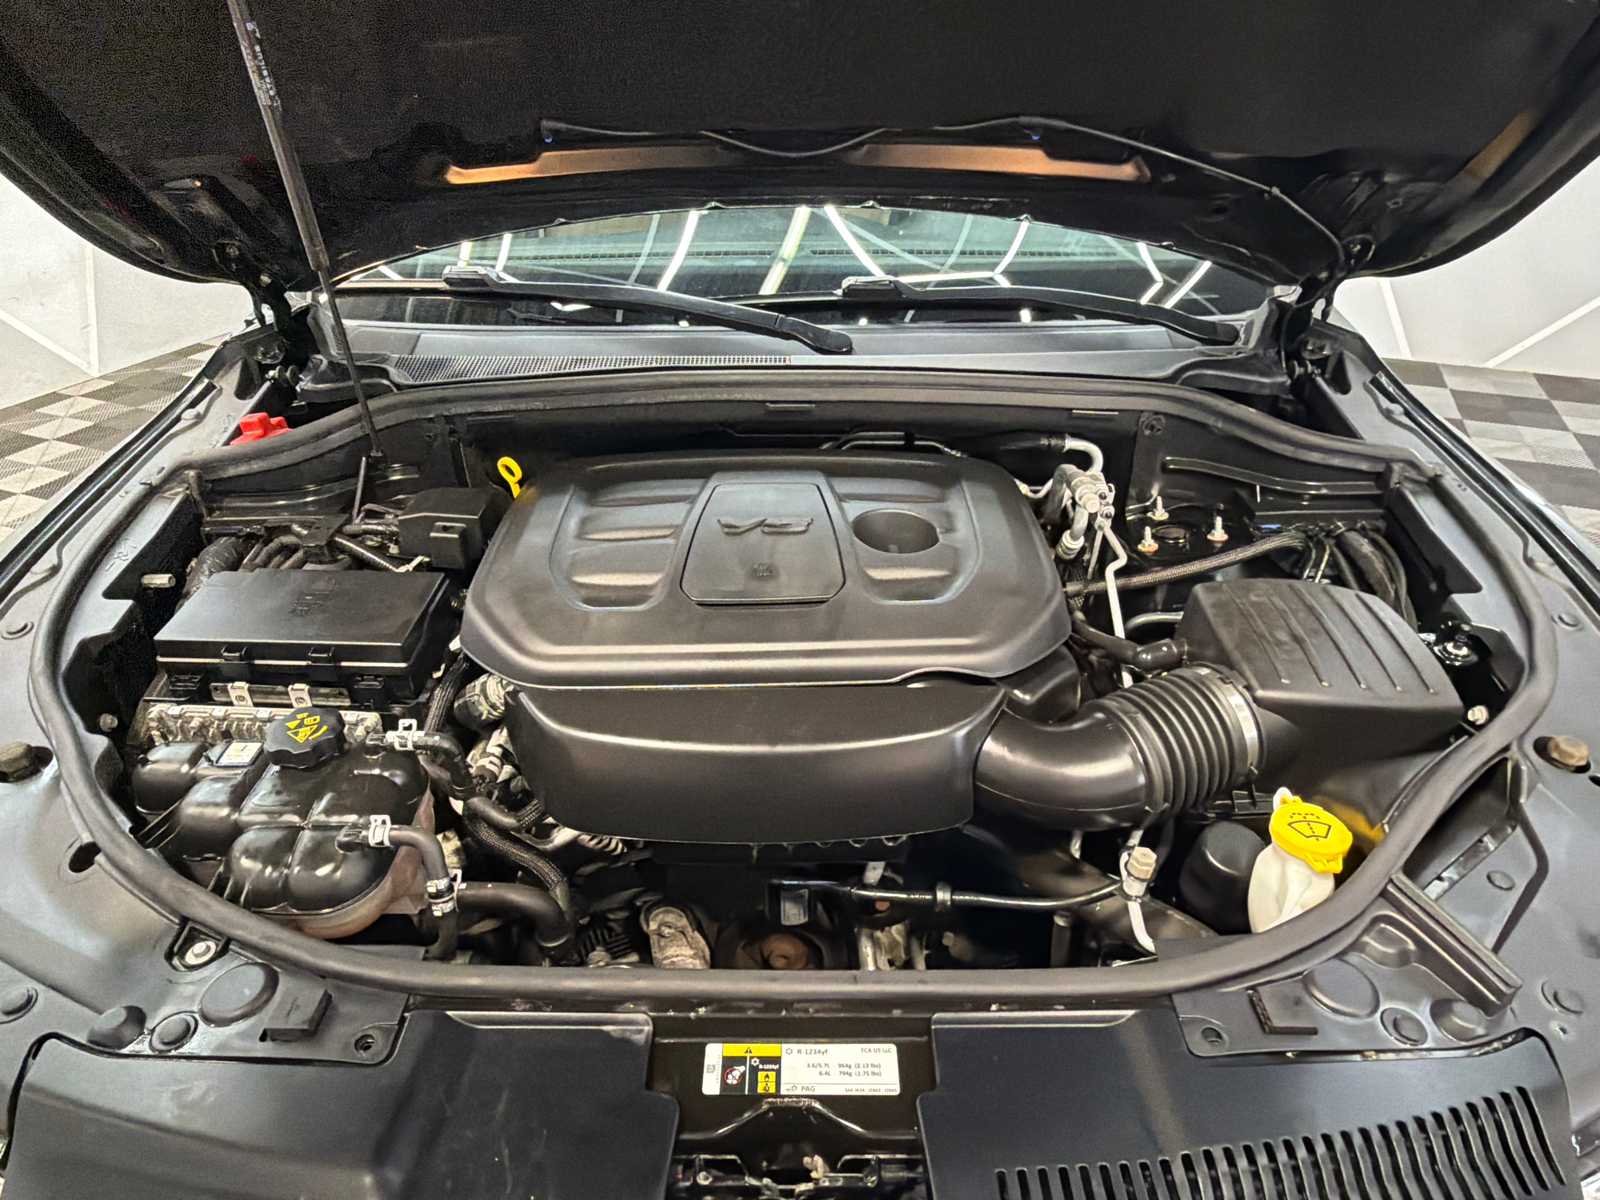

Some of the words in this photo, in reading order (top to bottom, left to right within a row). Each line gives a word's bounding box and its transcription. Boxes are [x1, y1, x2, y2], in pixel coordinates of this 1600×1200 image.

[797, 1048, 829, 1056] R-1234yf
[854, 1062, 870, 1070] (2.13
[870, 1062, 882, 1070] lbs)
[854, 1070, 870, 1078] (1.75
[870, 1070, 882, 1078] lbs)
